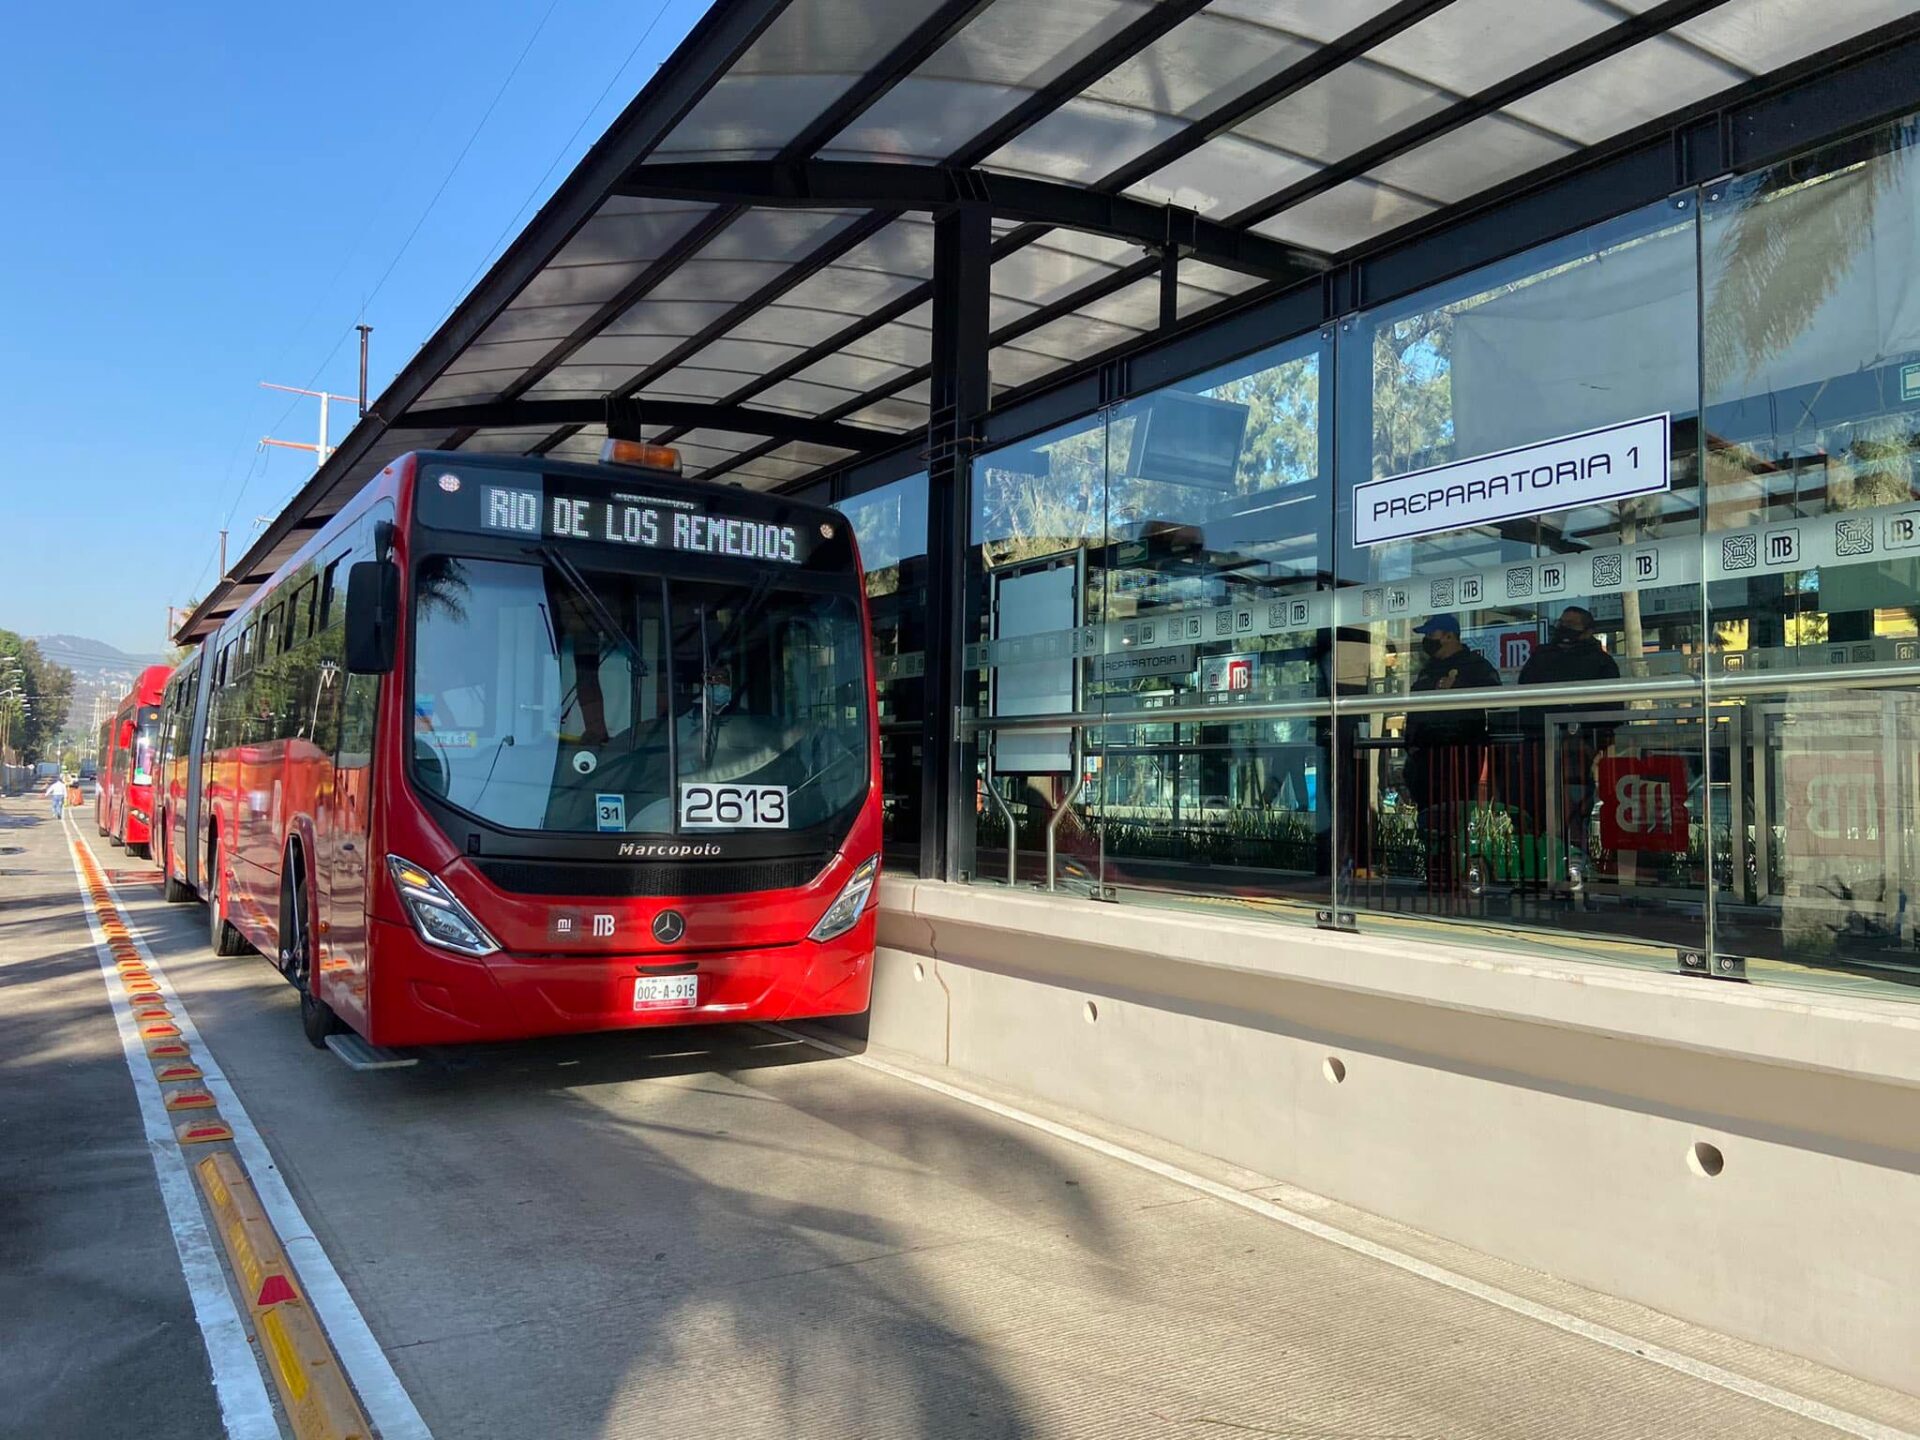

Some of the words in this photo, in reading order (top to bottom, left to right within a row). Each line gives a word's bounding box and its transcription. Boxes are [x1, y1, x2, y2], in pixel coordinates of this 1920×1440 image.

[1373, 453, 1611, 522] PREPARATORIA
[1626, 446, 1639, 469] 1
[489, 488, 537, 531] RIO
[553, 497, 590, 537] DE
[606, 504, 658, 545] LOS
[673, 512, 796, 561] REMEDIOS
[600, 806, 619, 820] 31
[685, 787, 785, 823] 2613
[618, 843, 721, 857] Marcopolo
[637, 983, 695, 1000] 002-A-915
